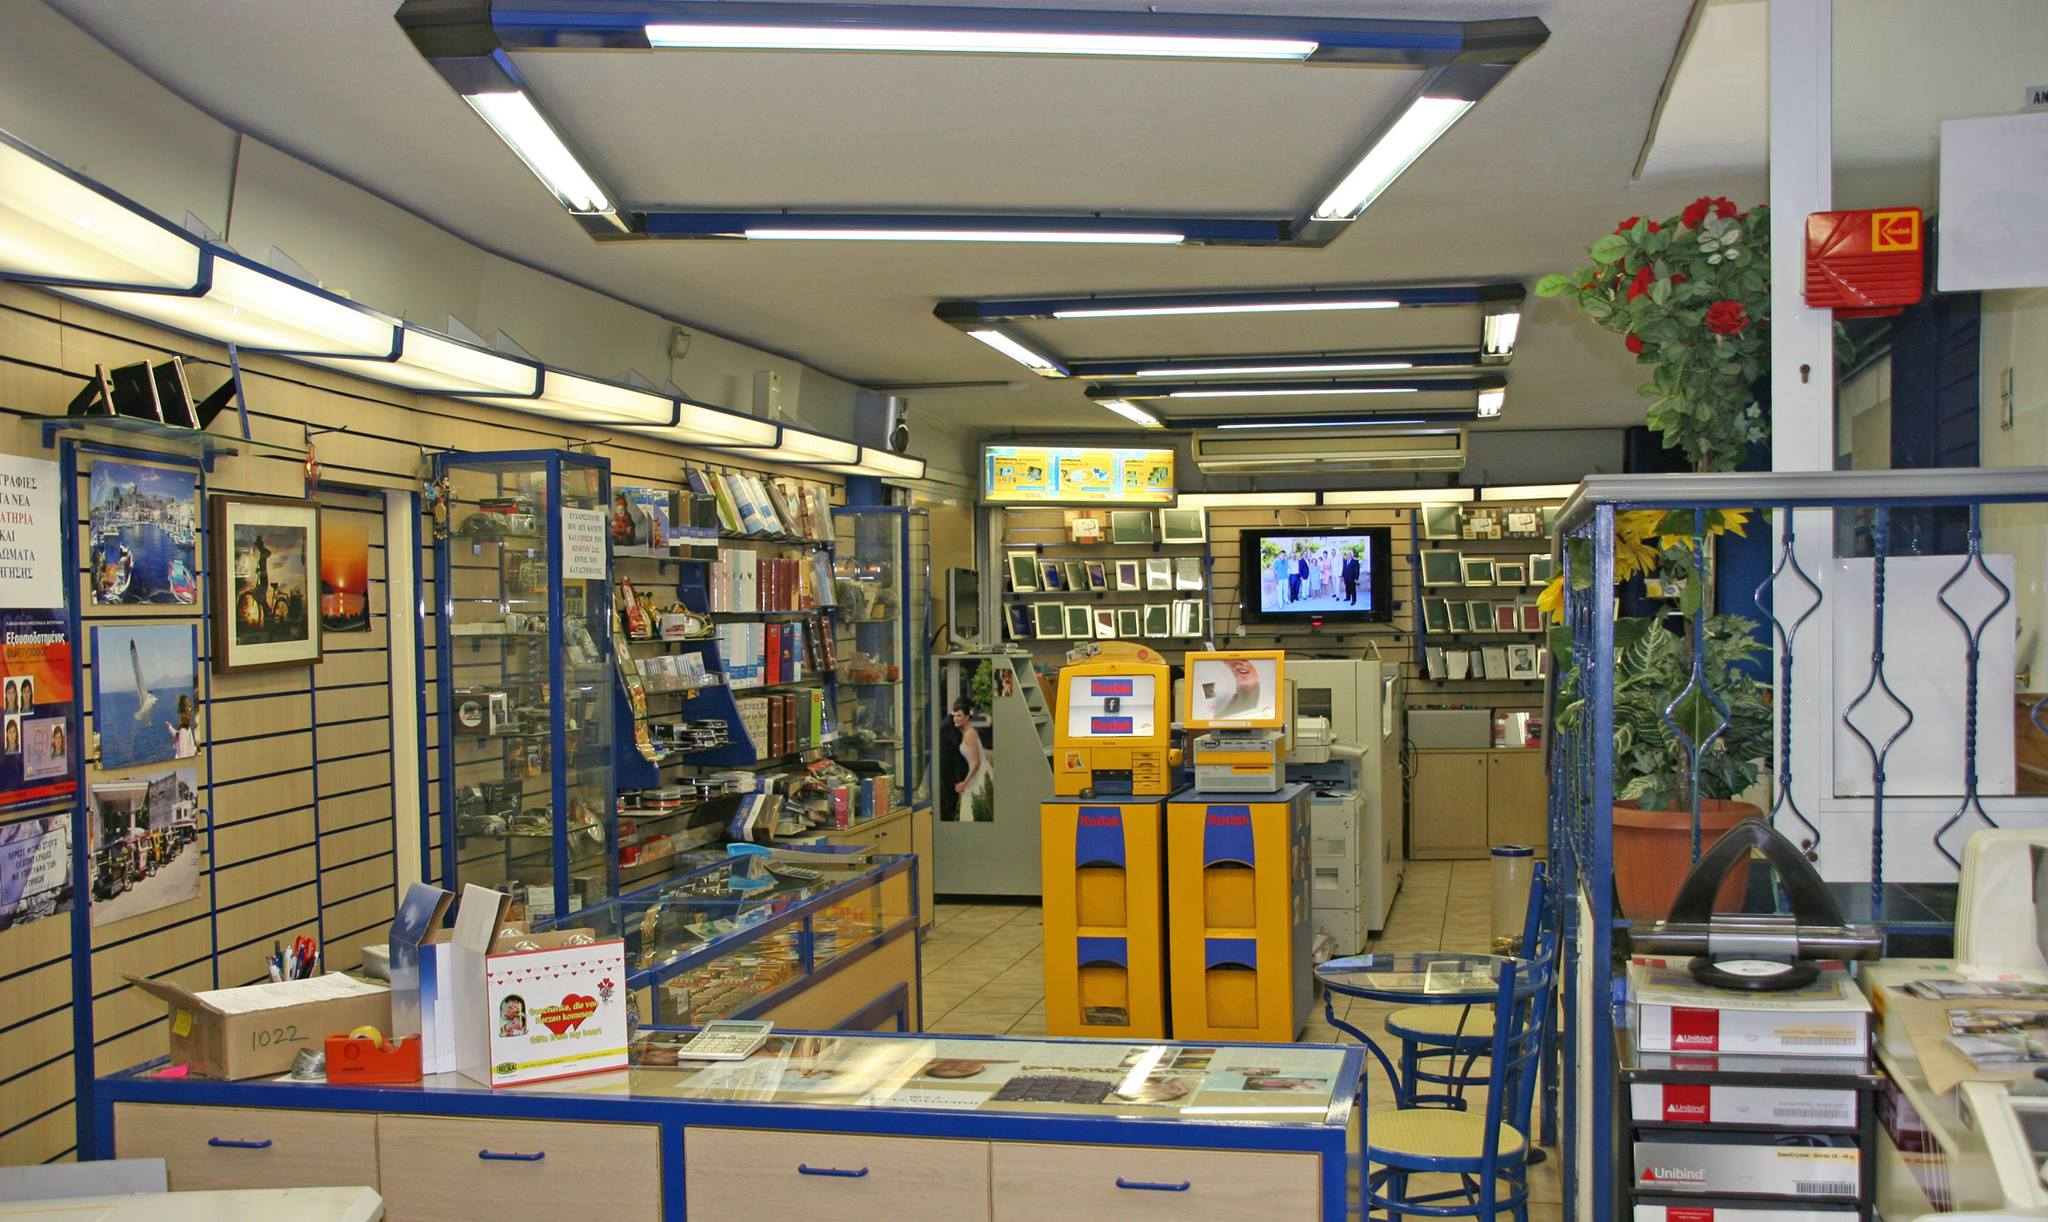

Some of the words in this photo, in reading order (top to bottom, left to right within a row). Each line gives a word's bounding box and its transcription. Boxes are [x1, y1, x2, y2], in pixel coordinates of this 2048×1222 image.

[1080, 815, 1120, 827] Kodak
[1207, 814, 1249, 826] Kodak
[252, 1025, 309, 1051] 1022
[1675, 1104, 1705, 1112] Unibind
[1654, 1167, 1704, 1180] Unibind
